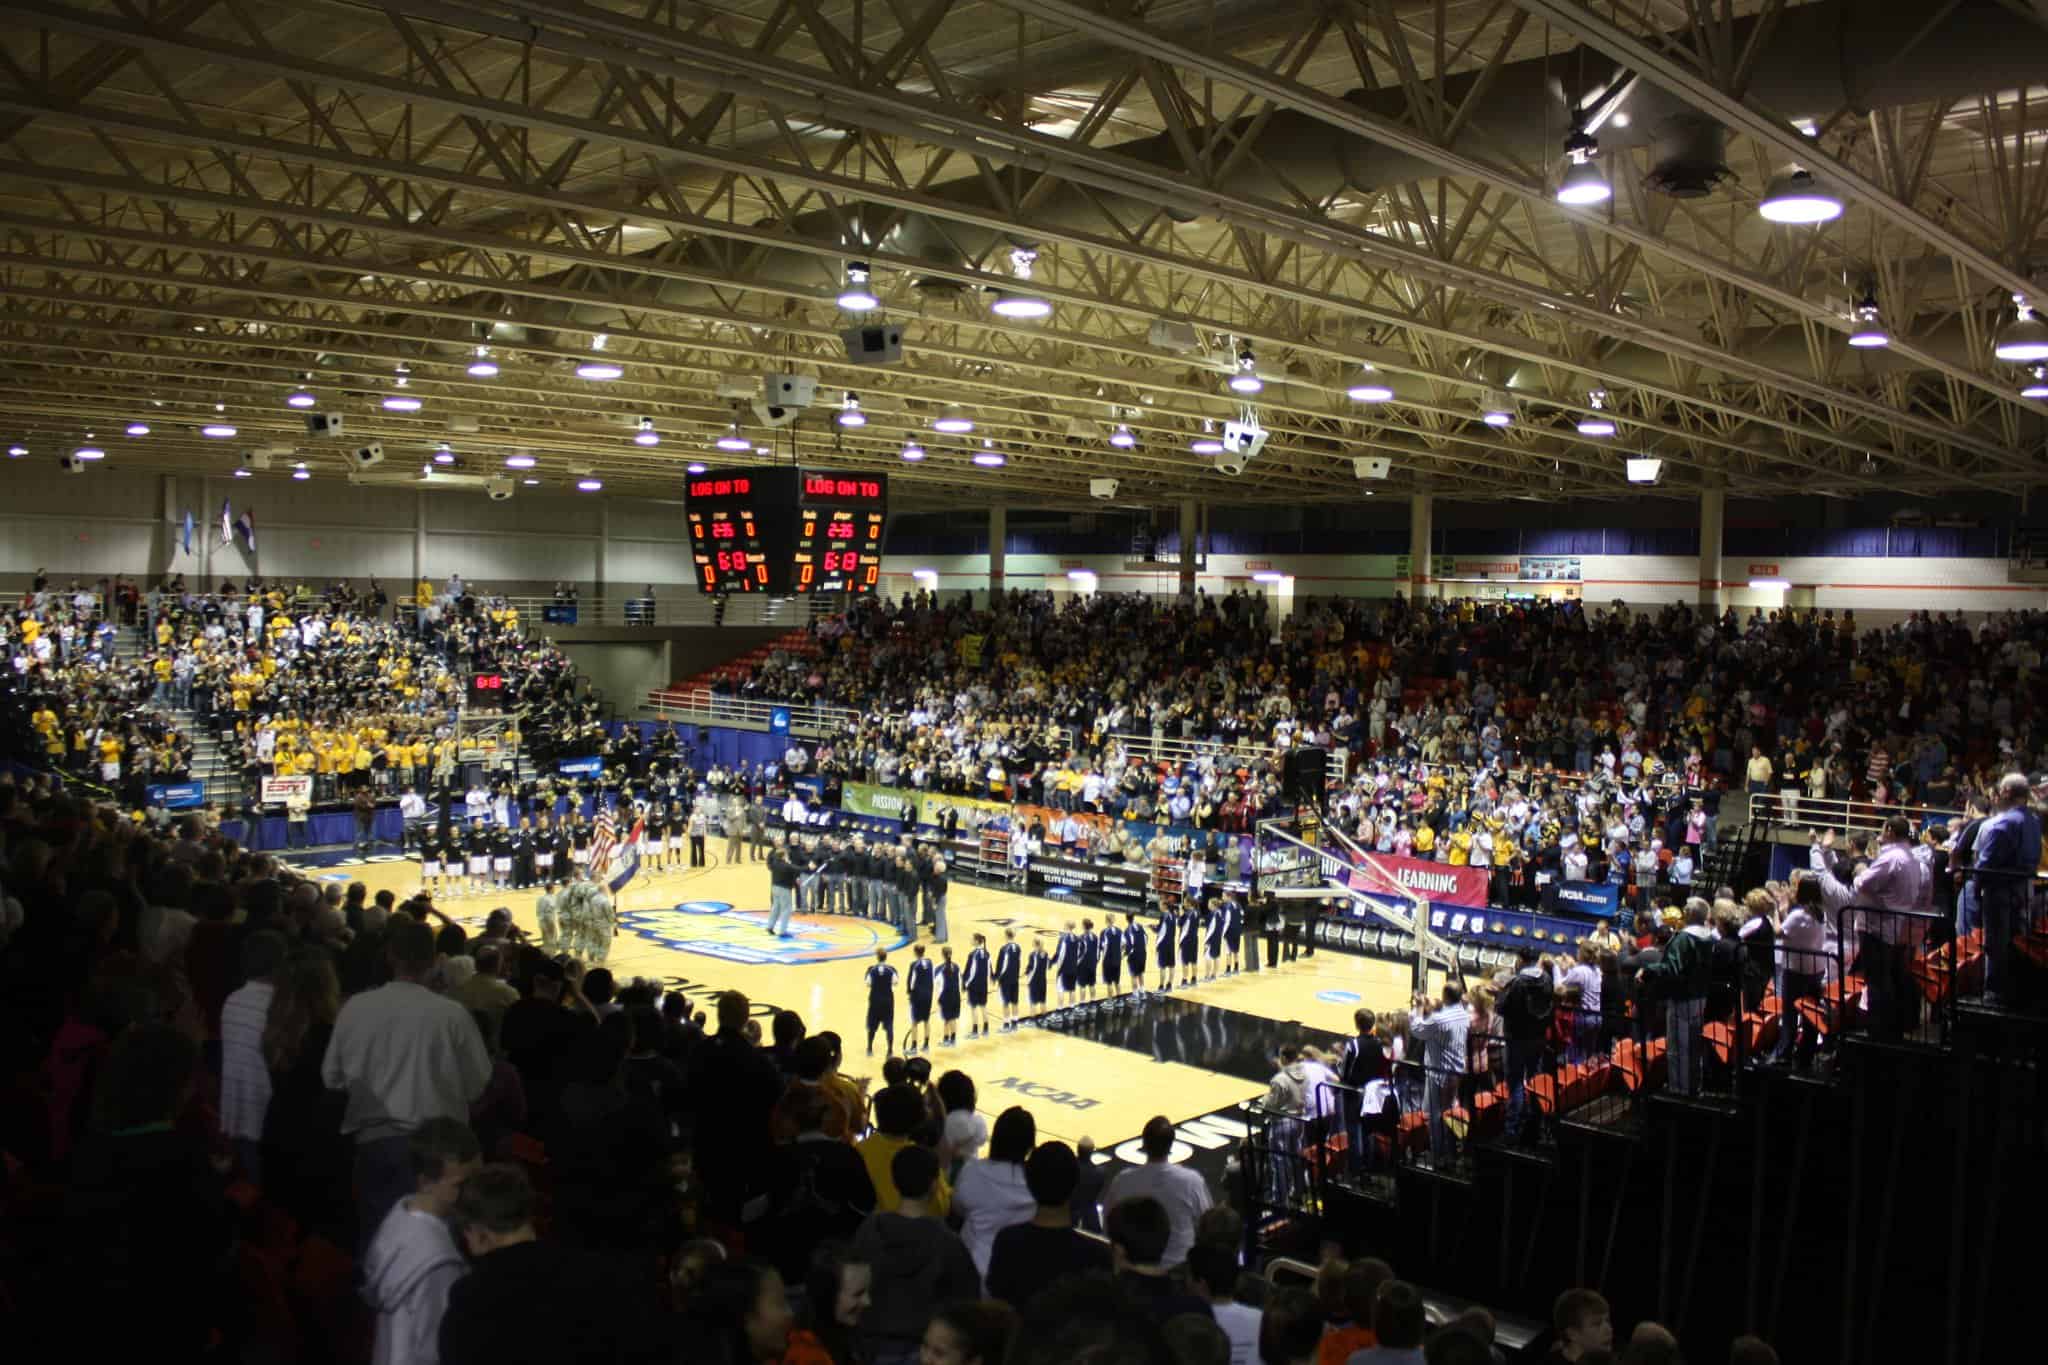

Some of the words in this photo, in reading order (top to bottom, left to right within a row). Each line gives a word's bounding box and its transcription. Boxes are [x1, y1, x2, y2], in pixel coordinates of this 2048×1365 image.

[691, 482, 713, 496] LOG
[714, 480, 732, 495] ON
[733, 479, 749, 493] TO
[806, 479, 833, 494] LOG
[837, 480, 857, 496] ON
[859, 481, 879, 496] TO
[695, 524, 704, 538] 0
[746, 522, 755, 536] 0
[805, 522, 814, 536] 0
[869, 524, 879, 539] 0
[704, 565, 715, 583] 0
[756, 565, 768, 583] 0
[801, 564, 814, 583] 0
[866, 566, 878, 584] 0
[871, 793, 903, 811] PASSION
[1398, 868, 1457, 894] LEARNING
[988, 1077, 1102, 1110] NCAA
